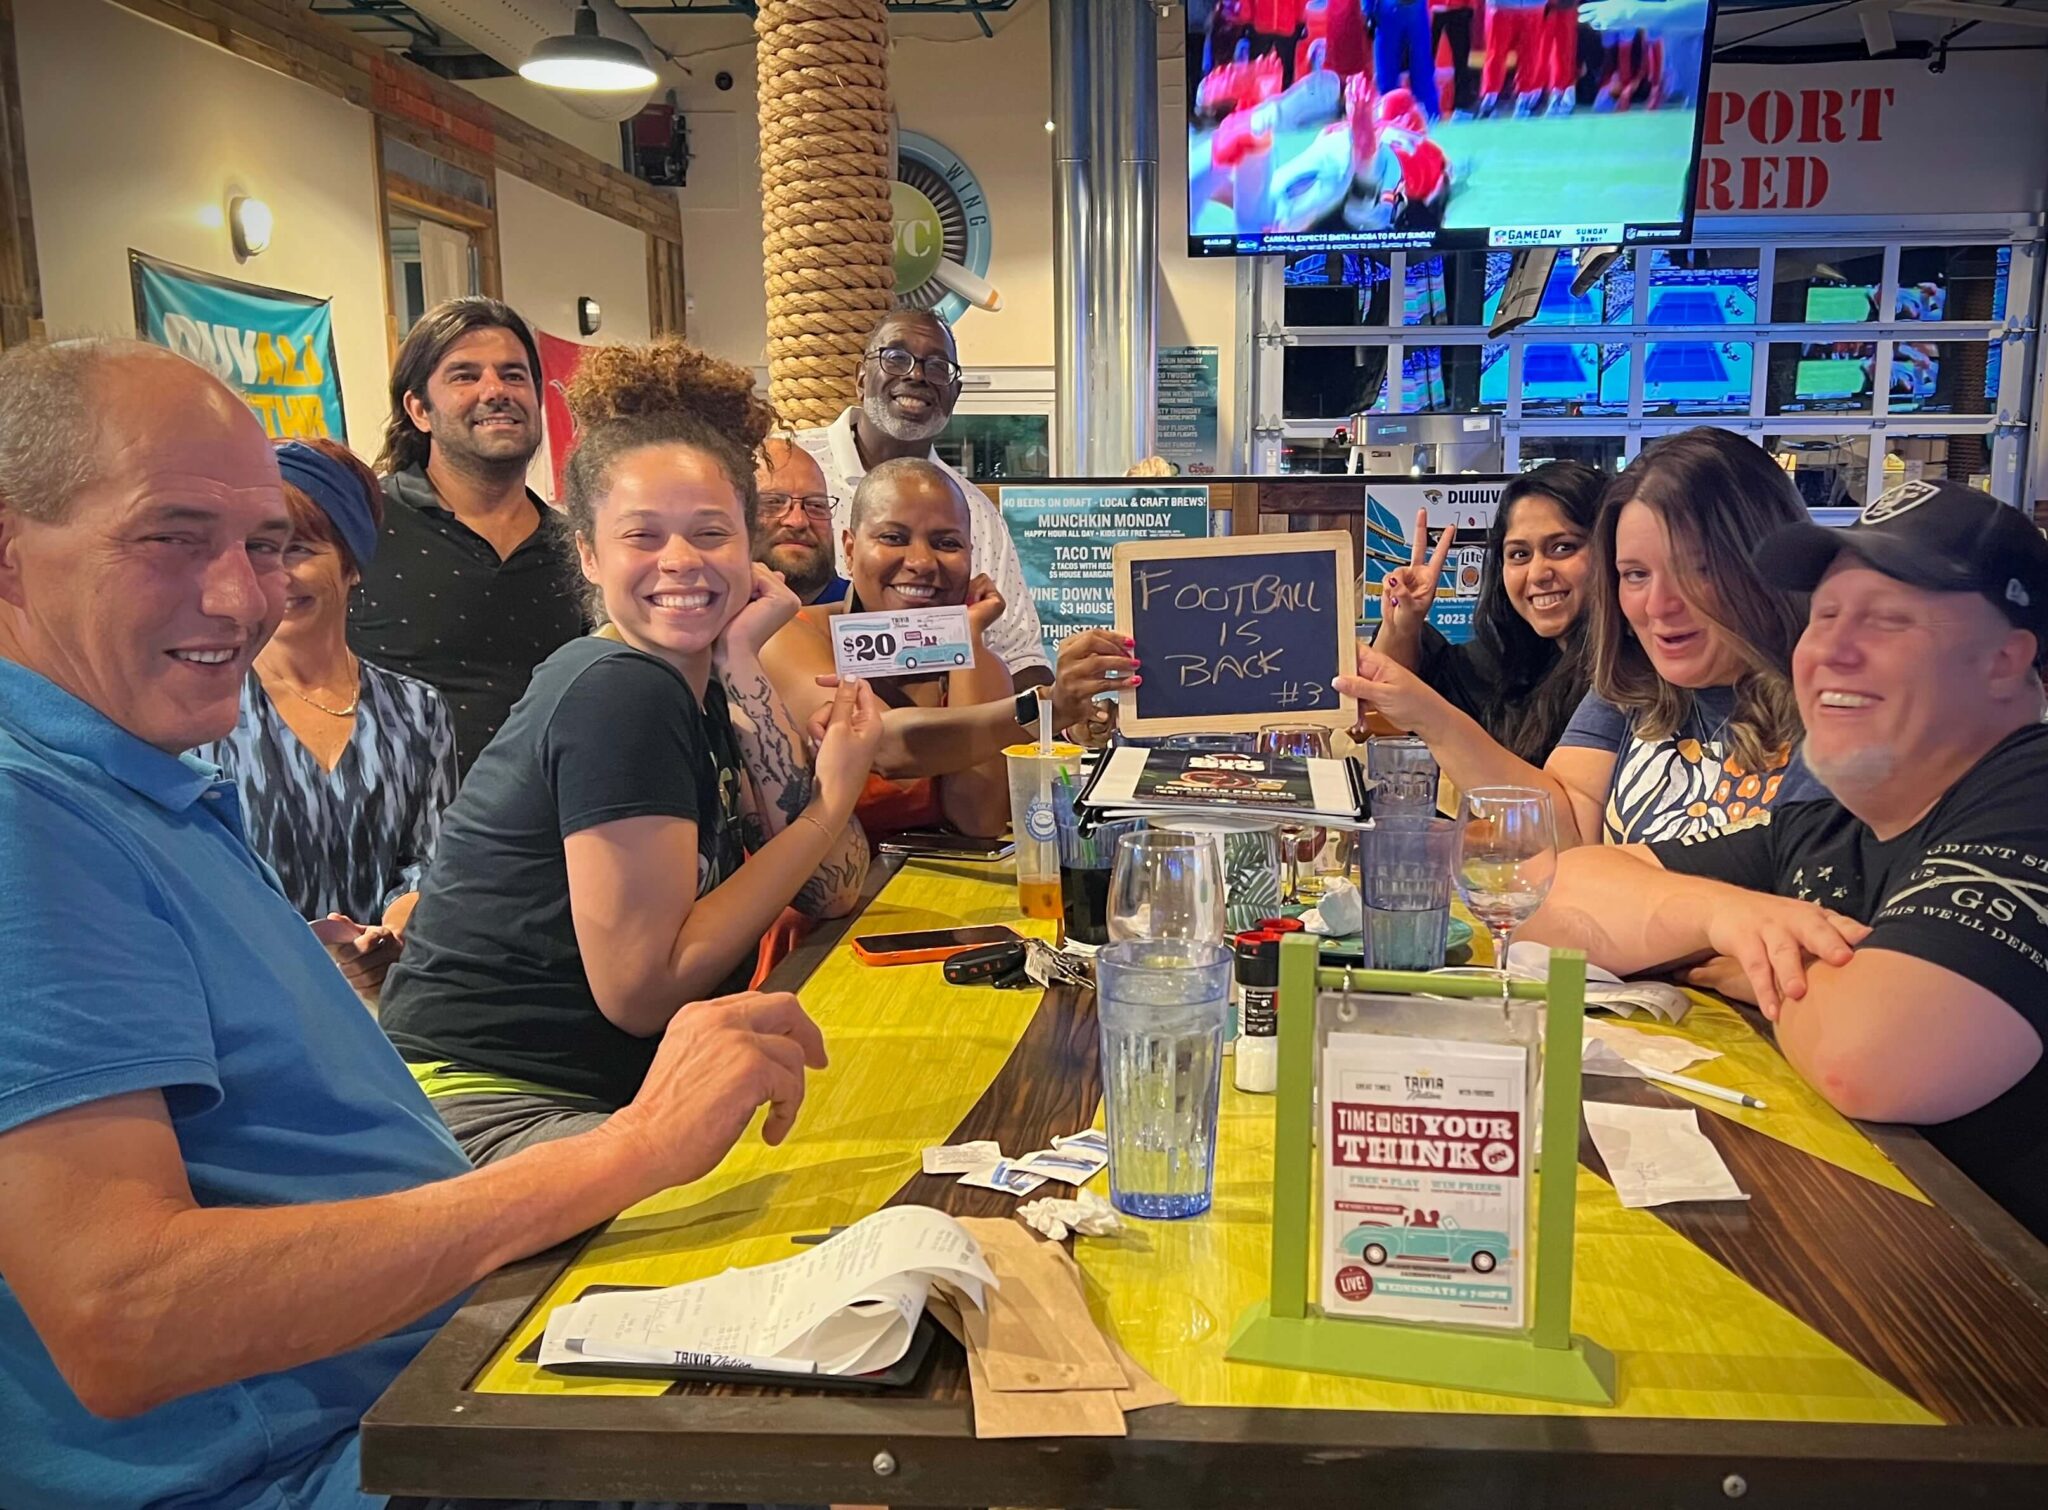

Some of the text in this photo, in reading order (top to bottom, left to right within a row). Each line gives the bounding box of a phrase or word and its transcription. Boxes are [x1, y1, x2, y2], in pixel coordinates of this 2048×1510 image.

[1703, 87, 1895, 145] PORT
[1695, 155, 1830, 211] RED
[945, 161, 988, 227] WING
[1388, 232, 1406, 240] PLAY
[1406, 231, 1436, 239] SUNDAY
[1508, 229, 1562, 240] GAMEDAY
[1003, 496, 1015, 508] 40
[1016, 496, 1046, 508] BEERS
[1048, 496, 1062, 508] ON
[1063, 496, 1093, 508] DRAFT
[1099, 497, 1129, 508] LOCAL
[1130, 497, 1139, 508] &
[1139, 496, 1170, 508] CRAFT
[1170, 496, 1207, 507] BREWS!
[1038, 512, 1172, 529] MUNCHKIN MONDAY
[1024, 530, 1047, 538] HAPPY
[1047, 530, 1067, 538] HOUR
[1068, 530, 1080, 538] ALL
[1081, 530, 1095, 538] DAY
[1100, 529, 1116, 538] KIDS
[1117, 529, 1131, 537] EAT
[1132, 529, 1148, 537] FREE
[1054, 546, 1089, 561] TACO
[1460, 551, 1483, 566] Lite
[1049, 571, 1058, 579] $5
[1059, 571, 1081, 579] HOUSE
[1050, 562, 1056, 570] 2
[1057, 562, 1079, 570] TACOS
[1079, 562, 1097, 570] WITH
[1061, 586, 1103, 601] DOWN
[1133, 568, 1322, 617] FOOTBALL
[1059, 602, 1114, 615] $3 HOUSE
[1437, 613, 1466, 625] 2023
[1218, 618, 1263, 647] IS
[843, 633, 897, 662] $20
[1164, 647, 1284, 687] BACK
[1268, 680, 1324, 707] #3
[1950, 887, 2018, 922] GS
[1922, 905, 1986, 932] WE'LL
[1404, 1075, 1445, 1090] TRIVIA
[1337, 1108, 1375, 1132] TIME
[1391, 1112, 1419, 1135] GET
[1420, 1114, 1514, 1141] YOUR
[1337, 1134, 1509, 1170] THINK ON
[1339, 1275, 1368, 1293] LIVE!
[674, 1350, 753, 1370] TRIVIA Nation
